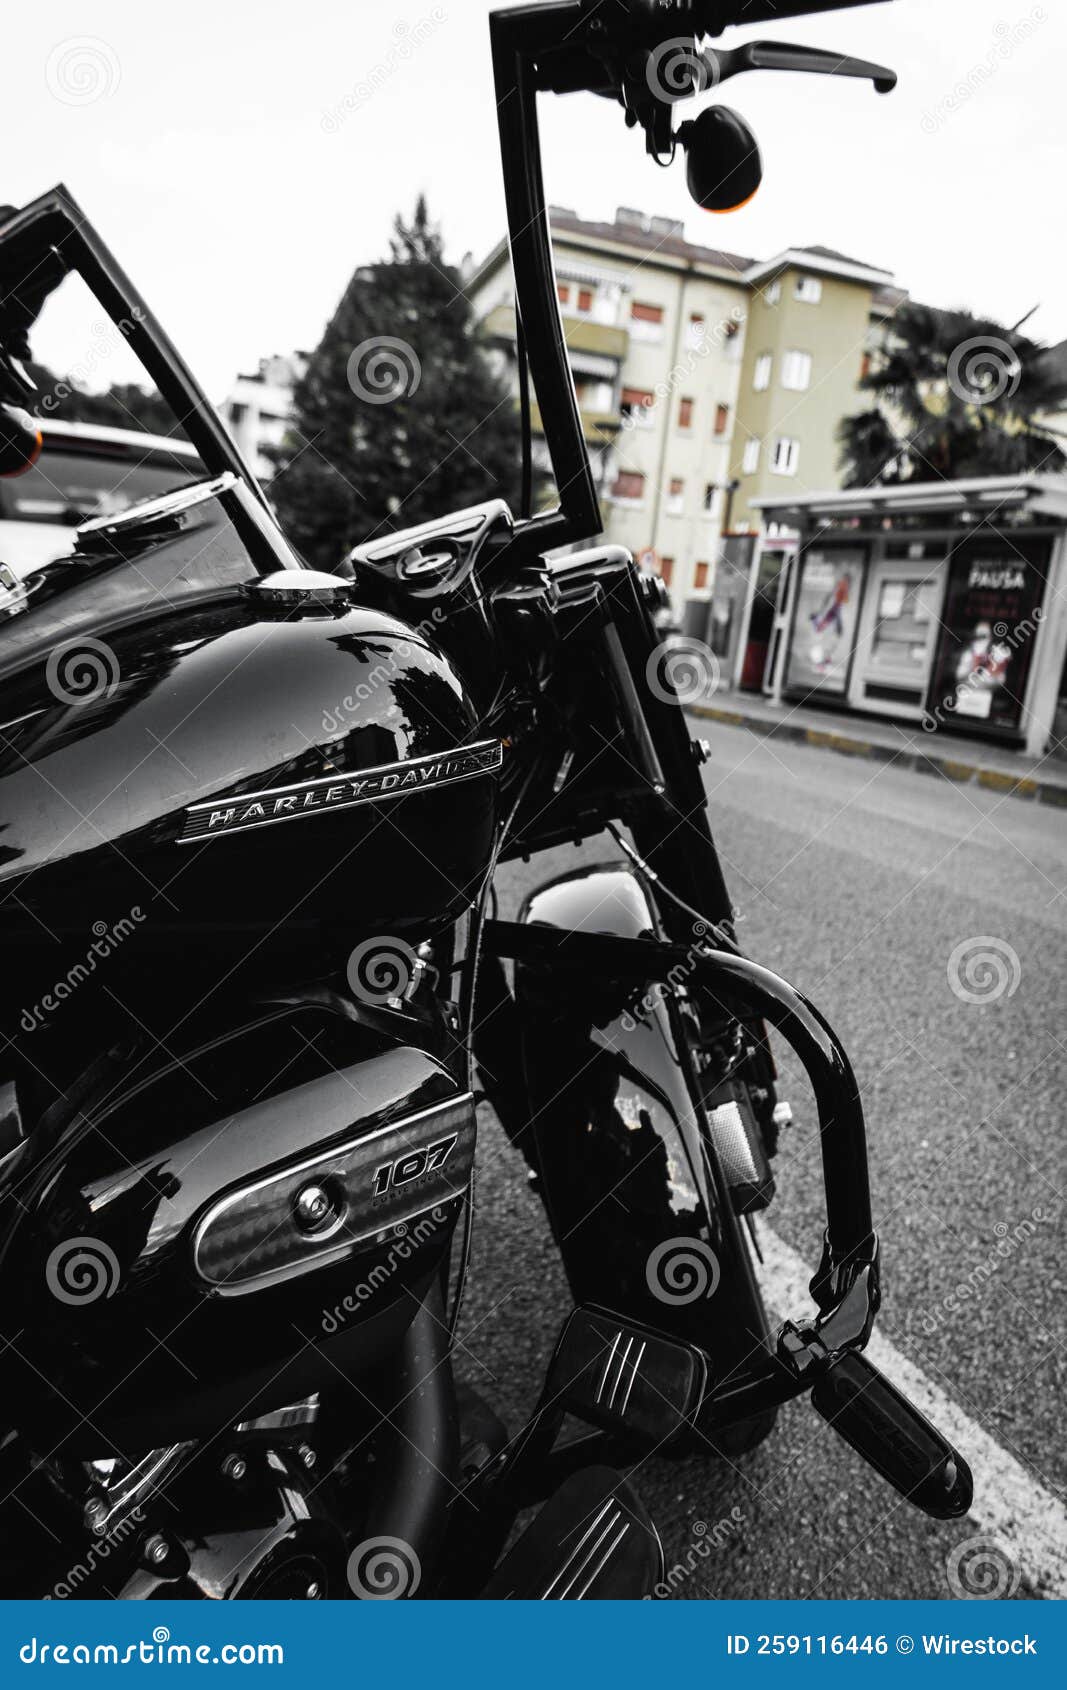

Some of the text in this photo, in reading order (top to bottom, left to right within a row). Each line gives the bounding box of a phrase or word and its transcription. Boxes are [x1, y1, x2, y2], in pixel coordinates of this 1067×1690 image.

[968, 570, 1026, 590] PAUSA
[208, 748, 501, 827] HARLEY-DAVID
[372, 1133, 458, 1196] 107
